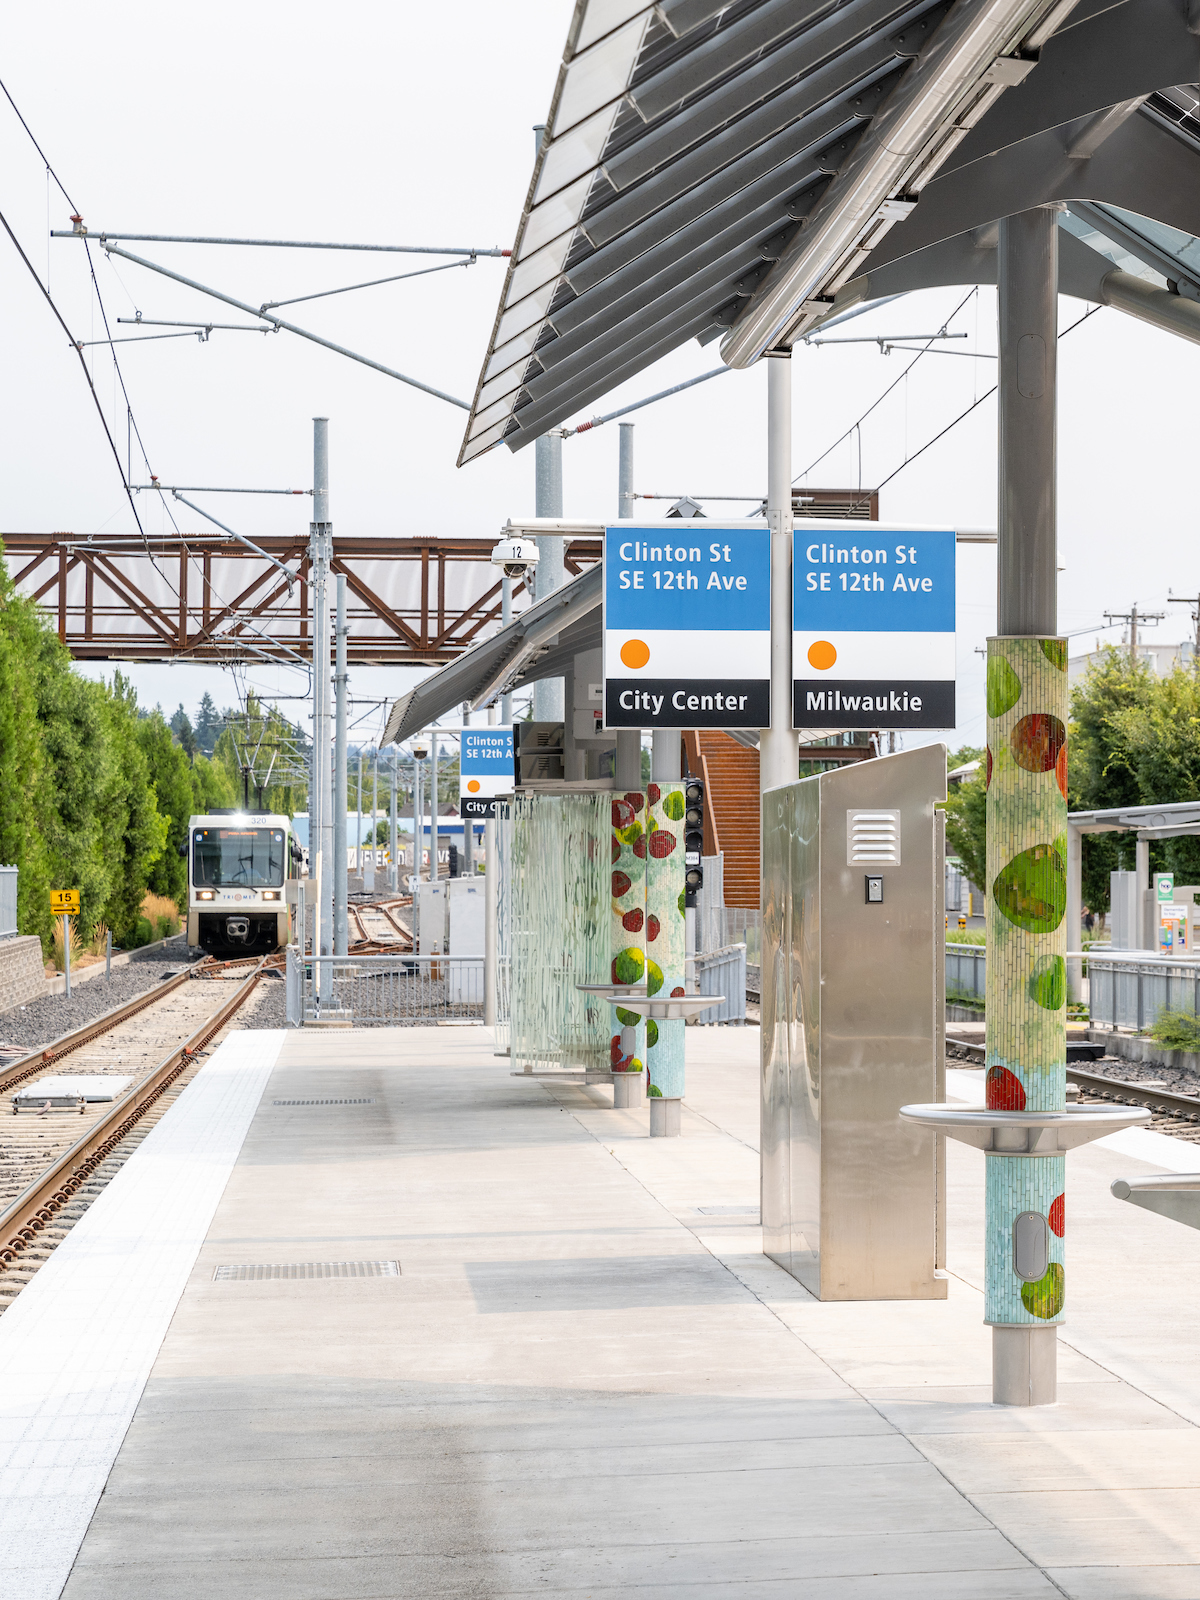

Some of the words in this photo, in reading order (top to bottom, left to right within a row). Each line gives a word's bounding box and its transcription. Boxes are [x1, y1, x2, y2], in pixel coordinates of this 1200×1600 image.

[512, 546, 522, 559] 12
[619, 541, 701, 562] Clinton
[709, 543, 732, 563] St
[806, 543, 887, 564] Clinton
[895, 544, 917, 565] St
[619, 570, 645, 590] SE
[652, 569, 699, 590] 12th
[706, 571, 748, 591] Ave
[806, 572, 832, 592] SE
[838, 571, 885, 592] 12th
[892, 573, 933, 593] Ave
[619, 689, 665, 716] City
[672, 690, 748, 711] Center
[806, 690, 922, 712] Milwaukie
[466, 736, 504, 746] Clinton
[506, 737, 513, 747] S
[466, 749, 479, 759] SE
[481, 748, 503, 759] 12th
[466, 801, 487, 814] City
[251, 817, 267, 825] 320
[58, 893, 72, 902] 15
